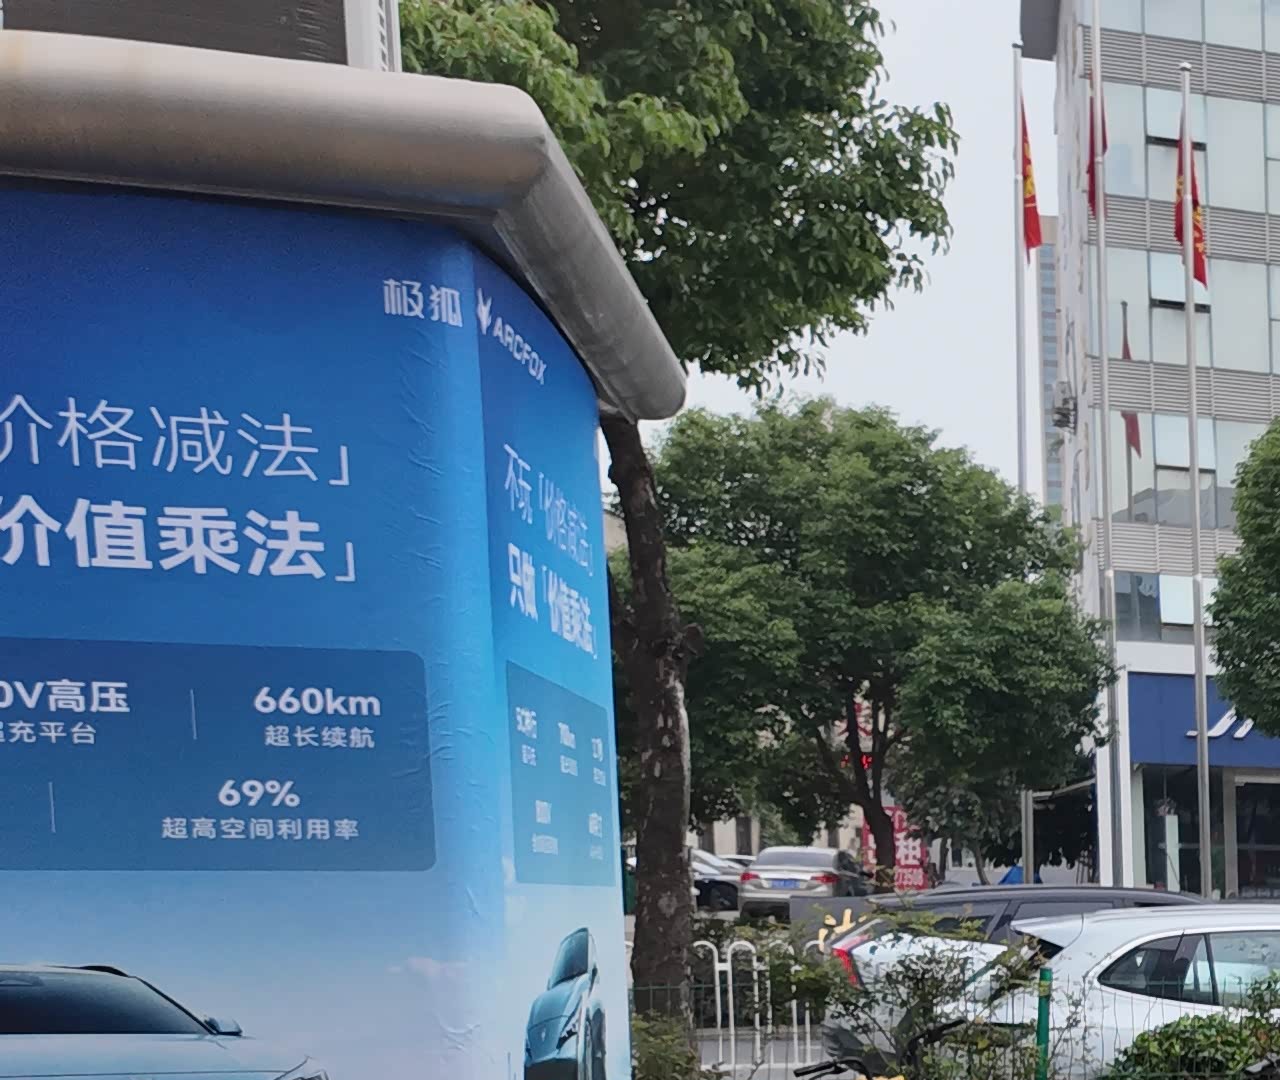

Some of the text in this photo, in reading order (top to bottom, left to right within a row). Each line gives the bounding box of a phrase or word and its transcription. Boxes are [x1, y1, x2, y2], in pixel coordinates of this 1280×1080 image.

[383, 278, 463, 327] 极狐
[493, 316, 547, 385] ARCFOX
[253, 687, 382, 717] 660km
[0, 721, 97, 745] 充平台
[264, 724, 375, 749] 超长续航
[218, 779, 301, 808] 69%
[161, 816, 360, 841] 超高空间利用率
